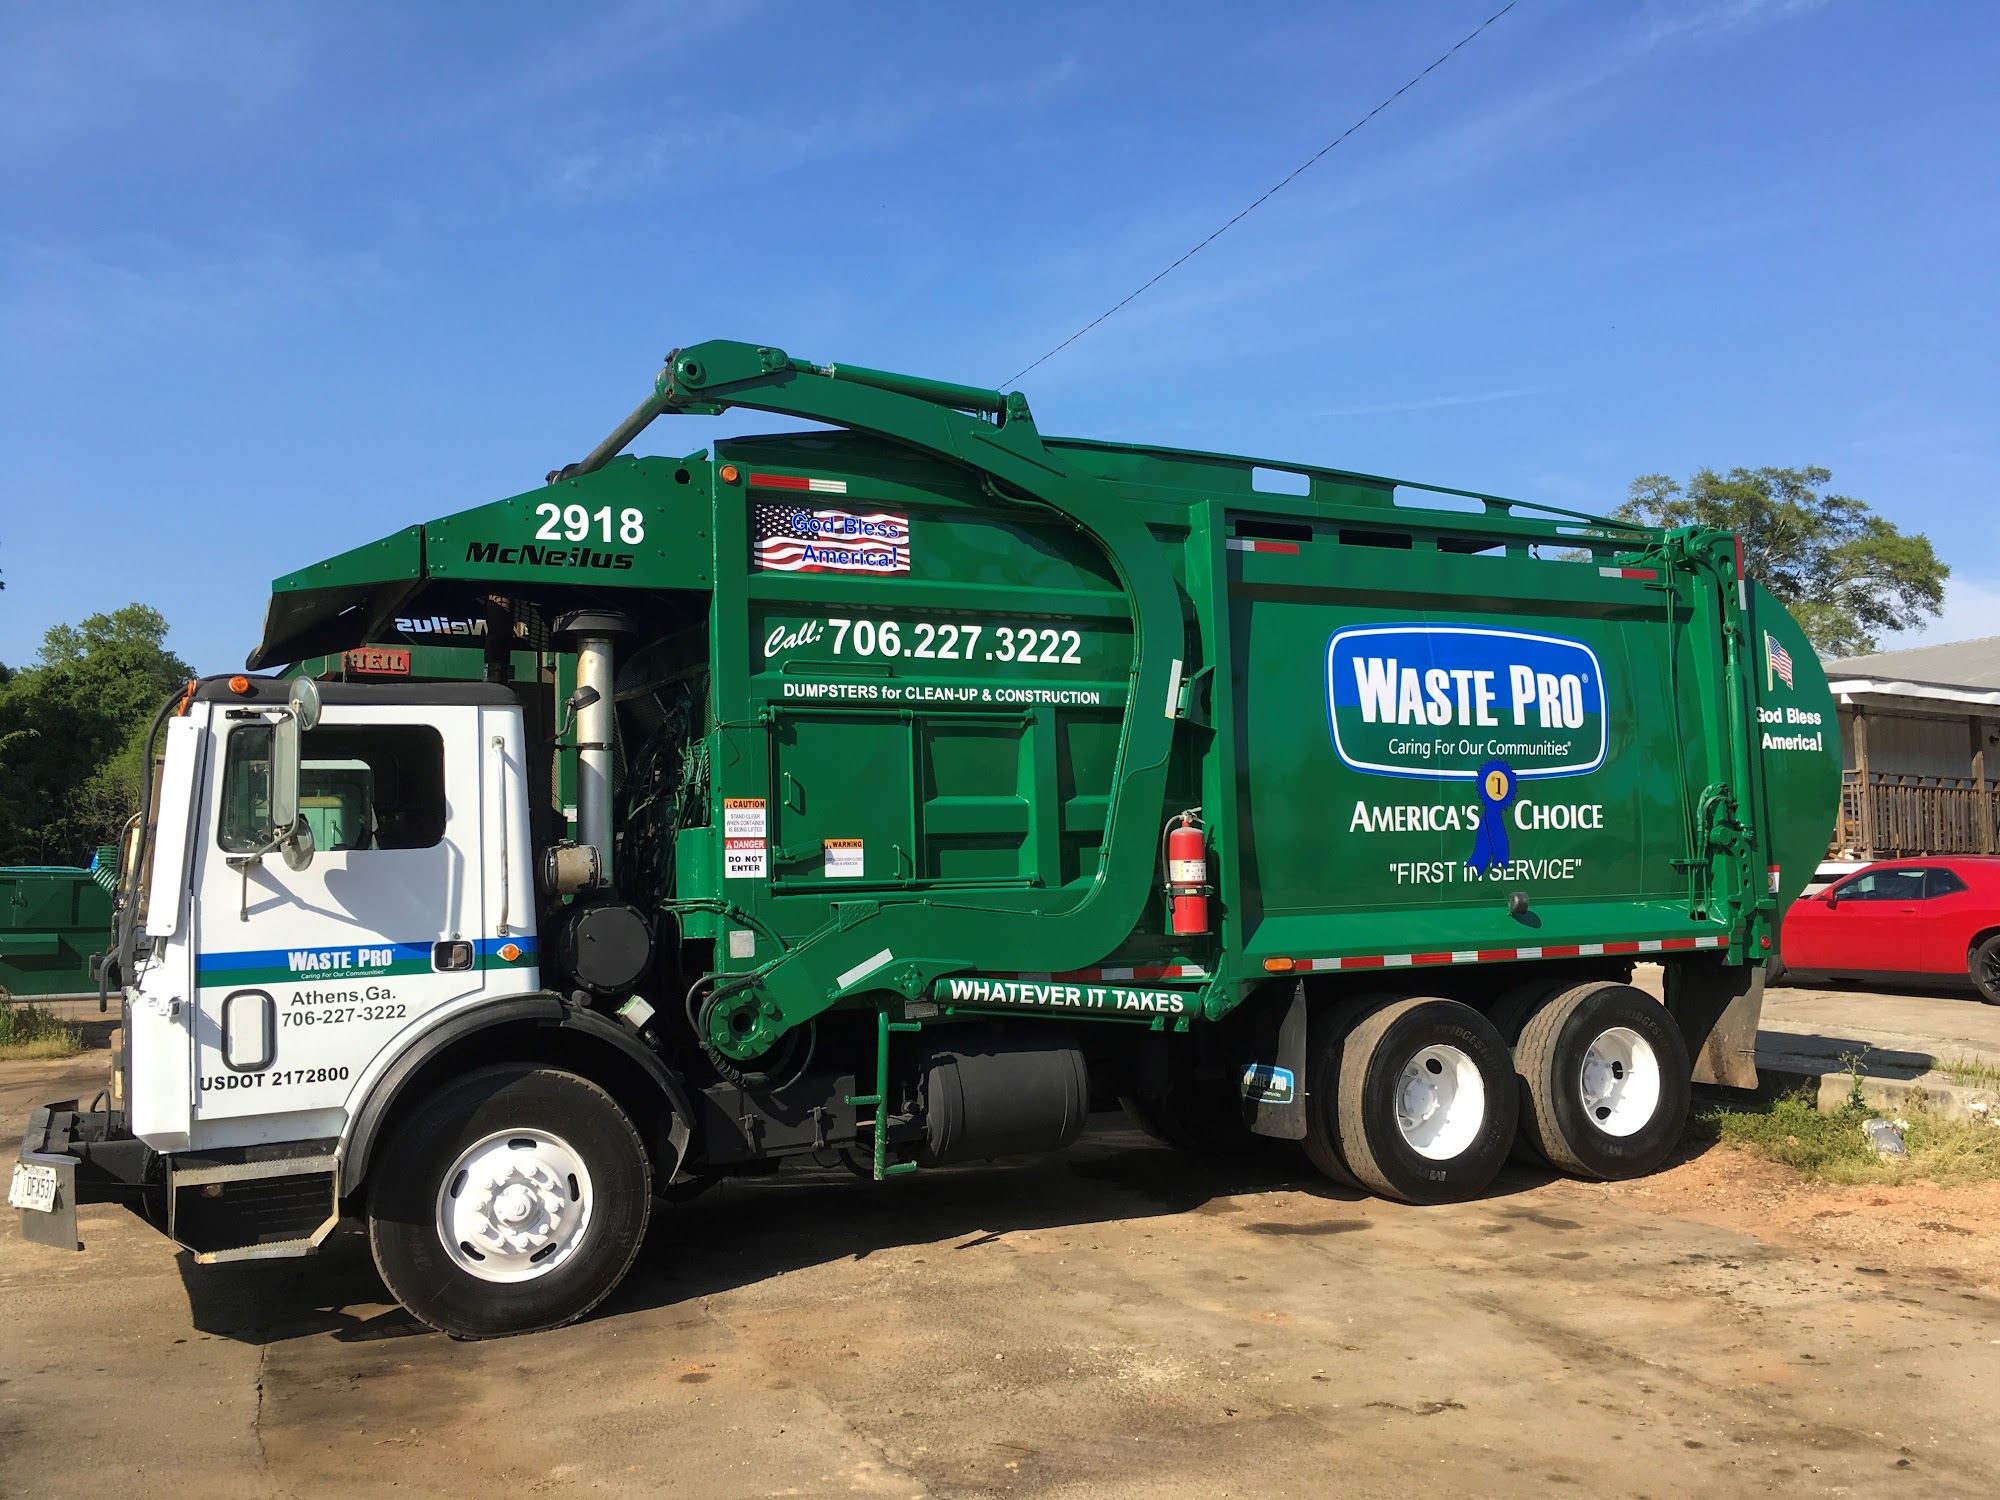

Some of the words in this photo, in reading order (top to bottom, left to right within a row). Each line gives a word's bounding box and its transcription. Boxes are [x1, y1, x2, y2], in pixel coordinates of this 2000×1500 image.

[535, 503, 645, 545] 2918
[791, 513, 834, 533] God
[844, 517, 899, 538] Bless
[465, 541, 635, 570] McNeilus
[801, 544, 897, 568] America!
[764, 620, 825, 657] Call:
[828, 618, 1082, 664] 706.227.3222
[348, 652, 406, 670] HEIL
[783, 683, 878, 699] DUMPSTERS
[881, 686, 902, 700] for
[905, 686, 979, 701] CLEAN-UP
[982, 688, 992, 702] &
[995, 688, 1100, 704] CONSTRUCTION
[1352, 656, 1499, 727] WASTE
[1756, 706, 1783, 724] God
[1786, 707, 1822, 726] Bless
[1388, 738, 1431, 759] Caring
[1437, 739, 1456, 755] For
[1459, 739, 1484, 755] Our
[1762, 731, 1823, 751] America!
[733, 800, 765, 808] CAUTION
[1349, 800, 1480, 832] AMERICA'S
[1514, 799, 1604, 830] CHOICE
[733, 840, 765, 849] DANGER
[288, 951, 352, 972] WASTE
[949, 979, 1081, 1006] WHATEVER
[1087, 988, 1106, 1008] IT
[1111, 990, 1184, 1014] TAKES
[282, 1003, 407, 1027] 706-227-3222
[200, 1073, 265, 1091] USDOT
[271, 1066, 350, 1087] 2172800
